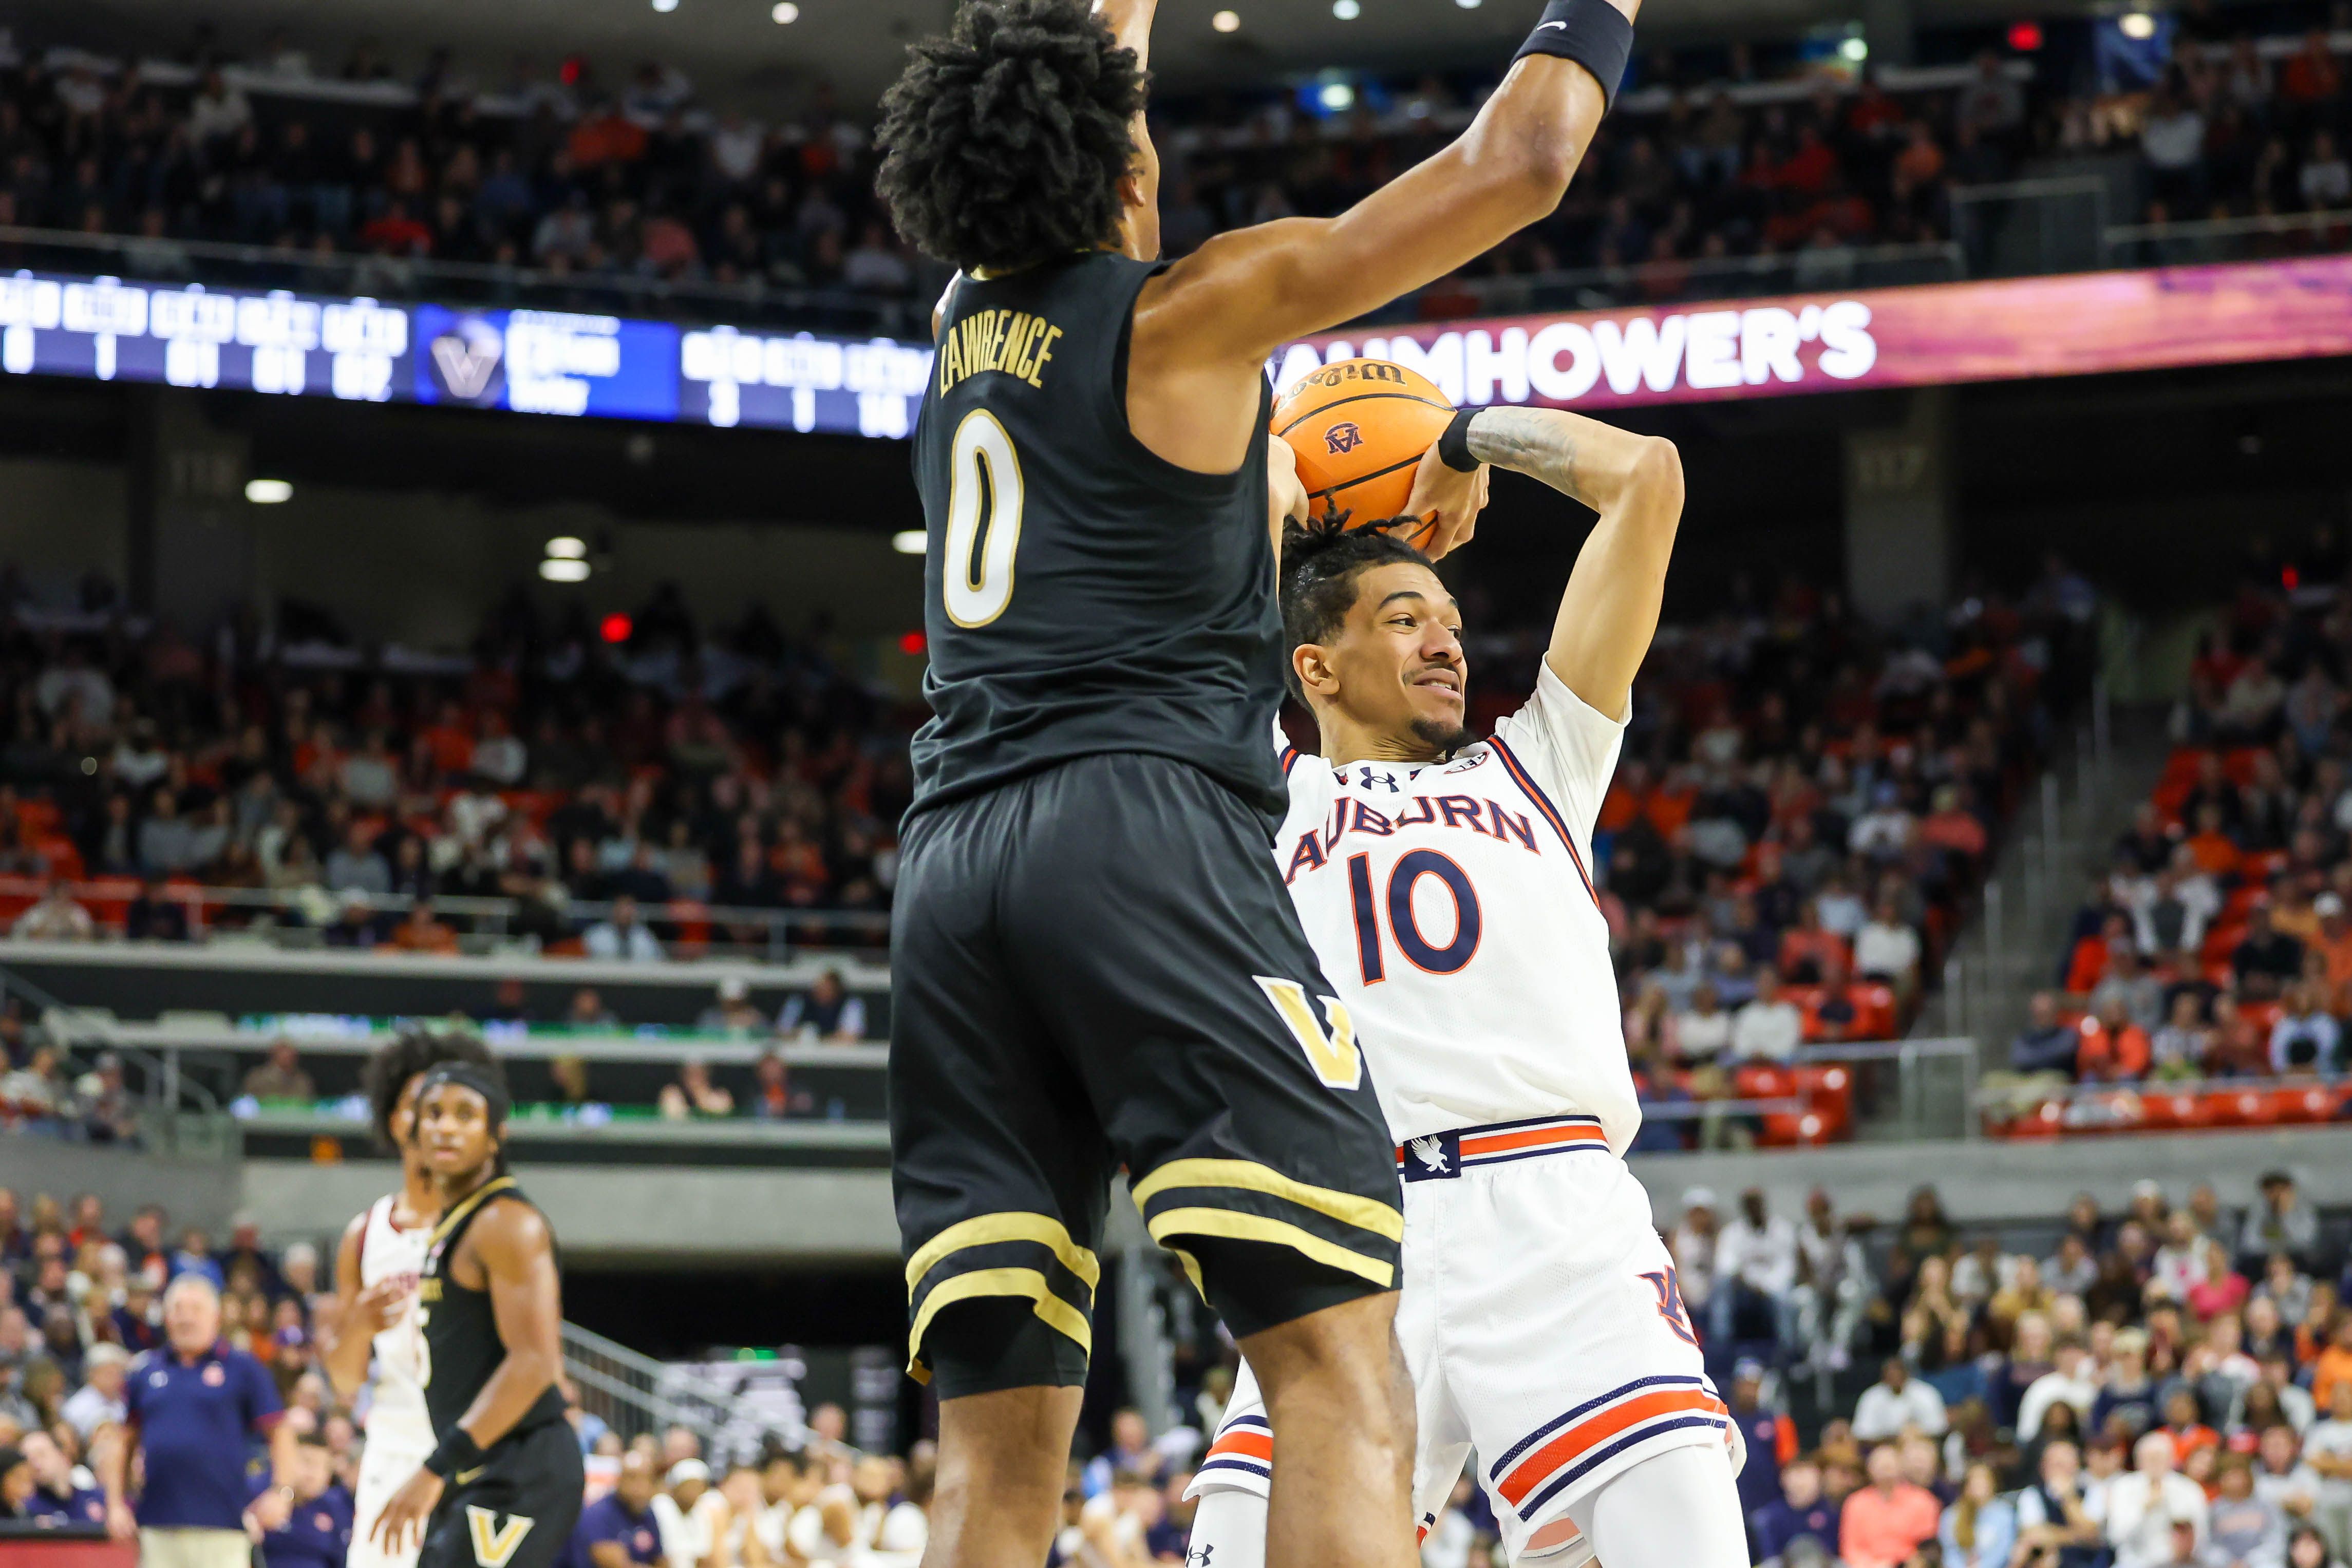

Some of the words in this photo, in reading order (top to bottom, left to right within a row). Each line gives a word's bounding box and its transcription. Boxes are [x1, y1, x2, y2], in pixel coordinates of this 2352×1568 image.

[940, 309, 1063, 400] LAWRENCE
[943, 408, 1024, 629] 0
[1285, 795, 1541, 886] AUBURN
[1347, 847, 1482, 987] 10
[1252, 975, 1362, 1091] V
[466, 1504, 535, 1567] V
